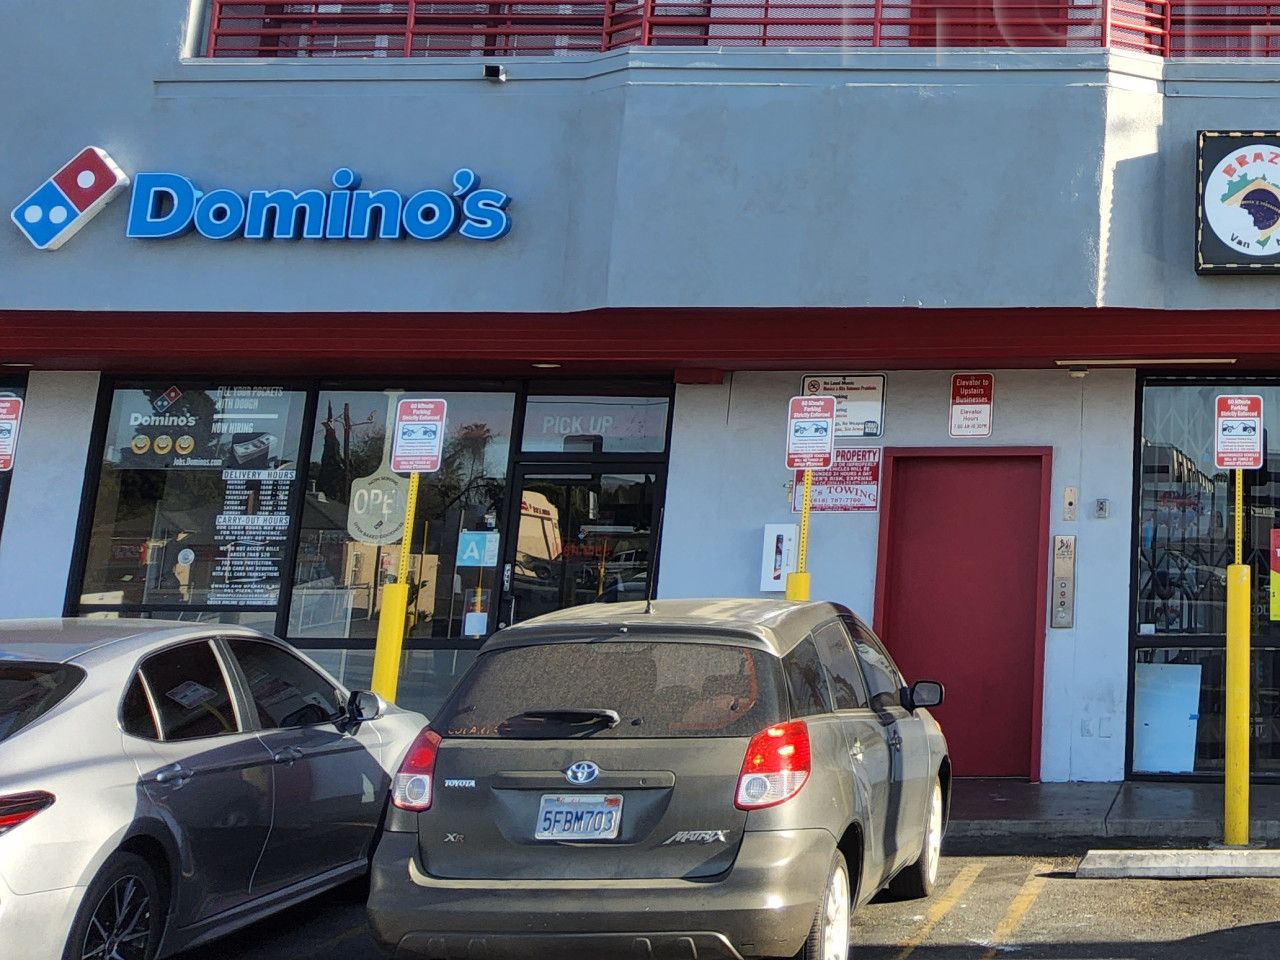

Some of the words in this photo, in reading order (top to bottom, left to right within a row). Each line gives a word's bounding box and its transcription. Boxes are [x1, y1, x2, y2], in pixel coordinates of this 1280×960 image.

[125, 167, 512, 242] Domino's
[1230, 232, 1251, 249] Van
[960, 387, 984, 395] Upstairs
[129, 412, 197, 427] Domino's
[543, 416, 585, 434] PICK
[588, 416, 613, 434] UP
[211, 422, 228, 434] NOW
[229, 422, 254, 434] HIRING
[836, 450, 878, 461] PROPERTY
[224, 471, 262, 480] DELIVERY
[267, 471, 295, 480] HOURS
[826, 485, 878, 502] TOWING
[217, 516, 260, 525] CARRY-OUT
[263, 516, 289, 525] HOURS
[462, 542, 480, 560] A
[444, 779, 476, 788] TOYOTA
[542, 810, 614, 833] 5FBM703
[444, 833, 464, 842] XR
[663, 829, 730, 845] MATRIX
